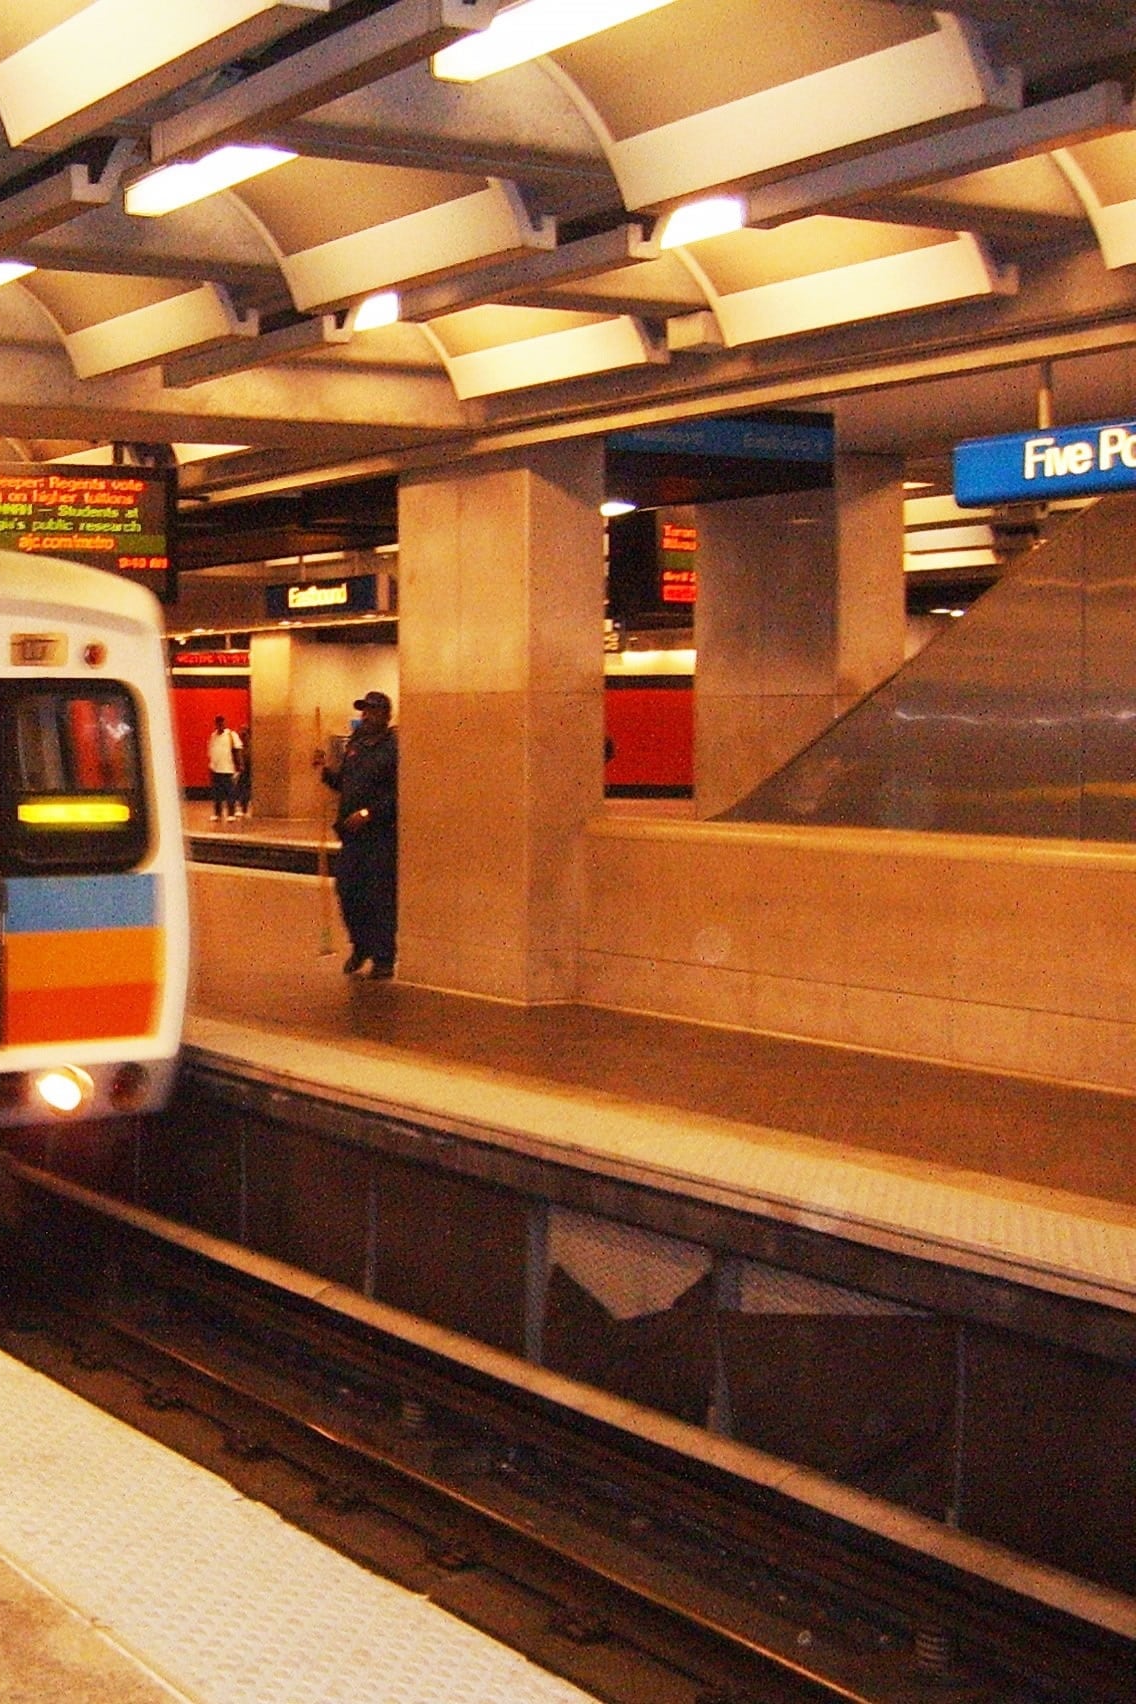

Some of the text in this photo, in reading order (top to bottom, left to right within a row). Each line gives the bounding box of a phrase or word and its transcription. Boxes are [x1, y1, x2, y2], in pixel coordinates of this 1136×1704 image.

[1024, 436, 1094, 480] Five
[7, 491, 28, 502] on
[57, 504, 120, 519] Students
[125, 507, 139, 519] at
[31, 517, 74, 532] public
[78, 519, 142, 533] research
